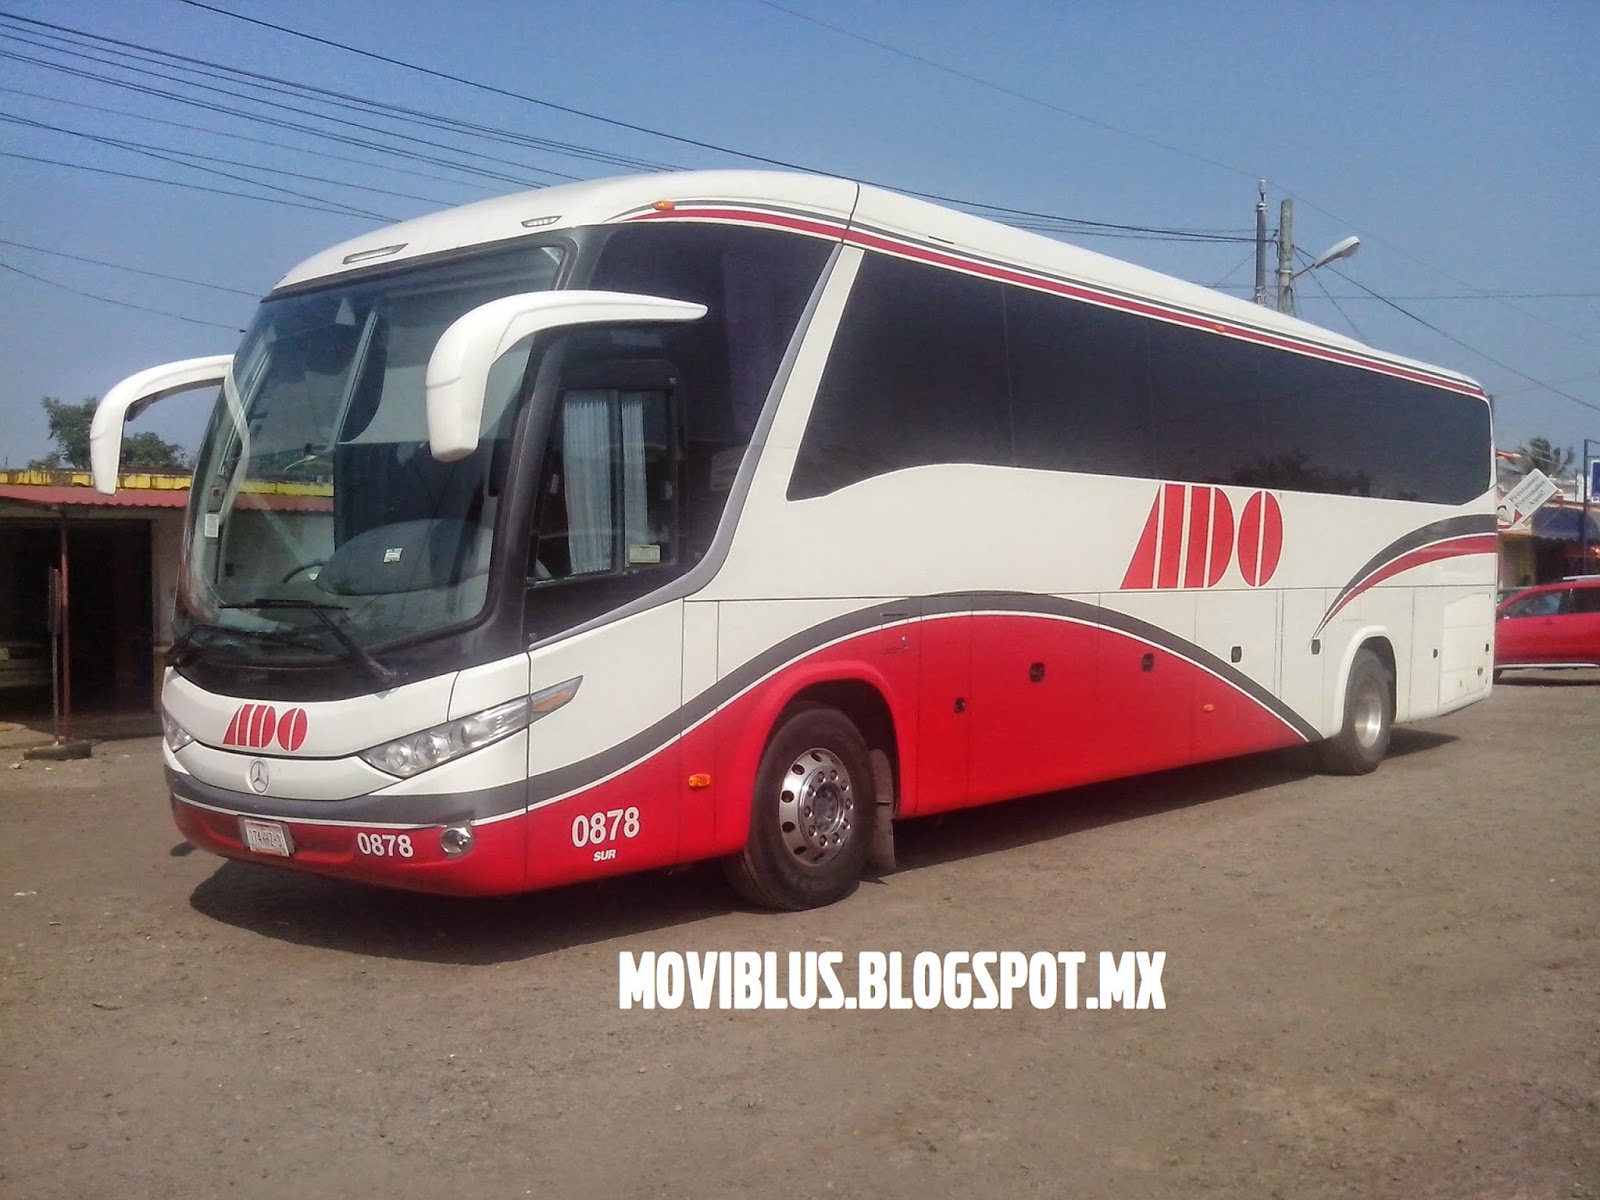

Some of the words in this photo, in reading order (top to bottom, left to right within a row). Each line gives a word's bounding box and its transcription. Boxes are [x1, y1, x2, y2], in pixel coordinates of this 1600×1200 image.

[1120, 483, 1283, 590] ADO
[223, 703, 309, 751] ADO
[356, 832, 414, 858] 0878
[571, 806, 640, 848] 0878
[593, 849, 617, 862] SUR
